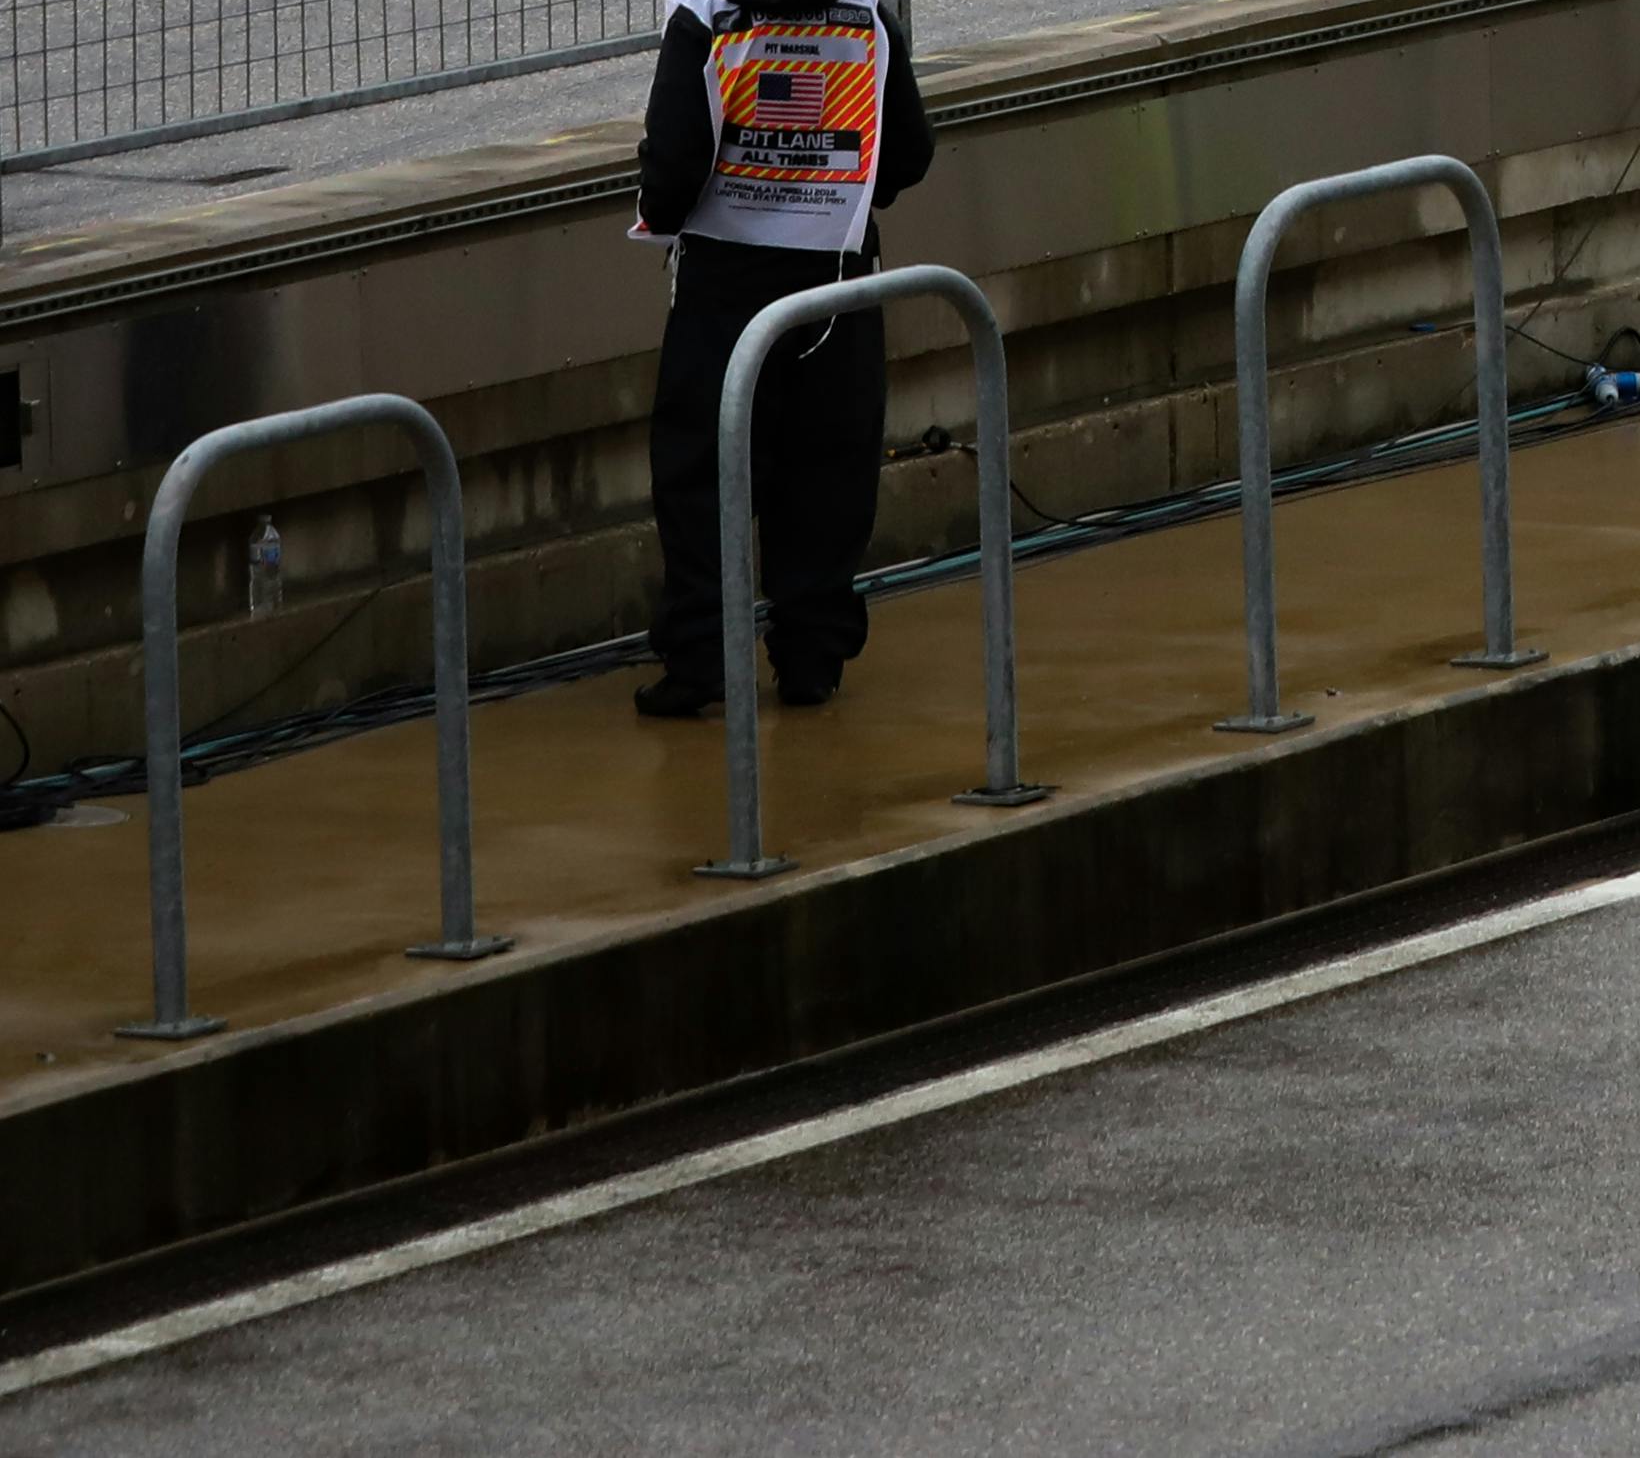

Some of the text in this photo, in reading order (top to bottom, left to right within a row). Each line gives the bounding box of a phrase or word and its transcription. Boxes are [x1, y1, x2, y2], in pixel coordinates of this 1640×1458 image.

[765, 44, 778, 54] PIT
[740, 130, 836, 150] PIT LANE
[742, 151, 830, 167] ALL TIMES
